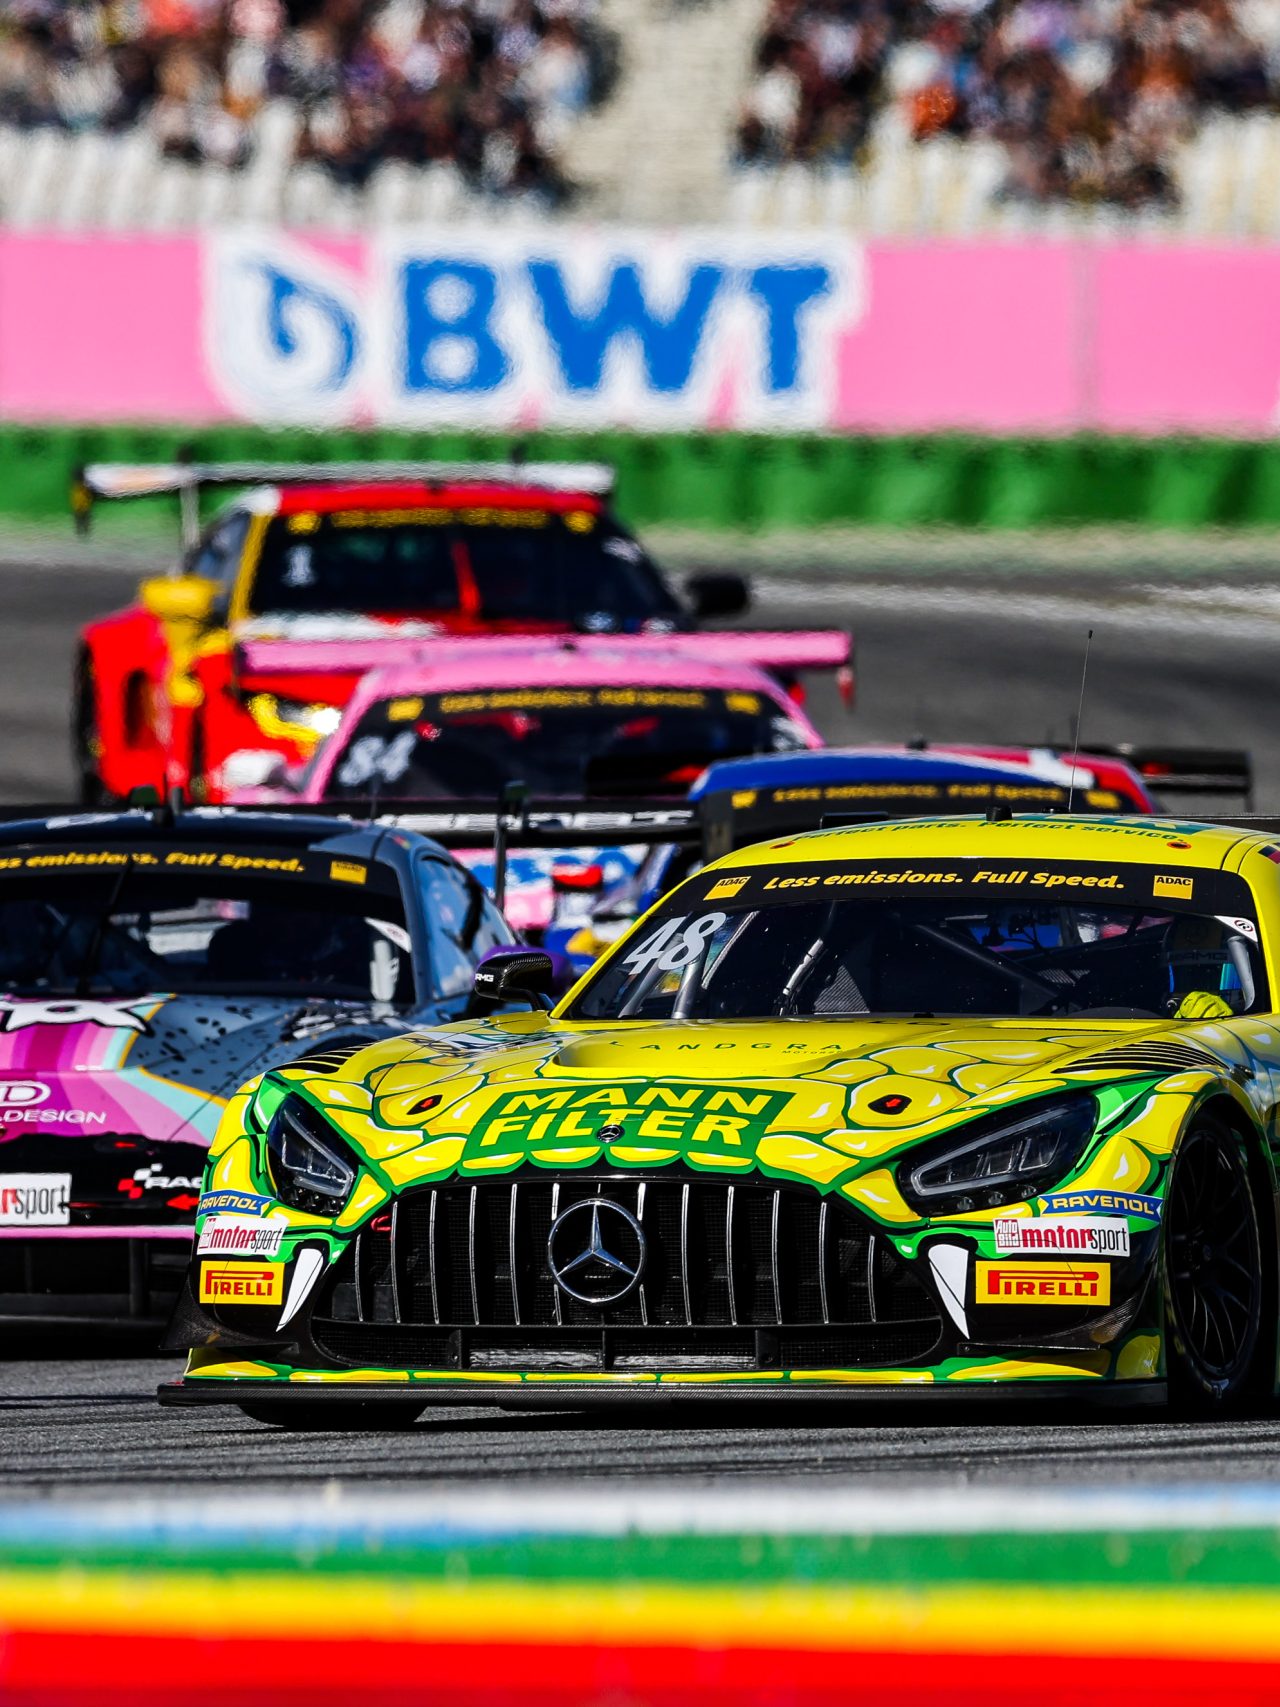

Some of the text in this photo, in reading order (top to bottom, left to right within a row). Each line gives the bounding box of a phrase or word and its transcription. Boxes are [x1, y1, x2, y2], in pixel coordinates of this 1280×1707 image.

[404, 260, 831, 393] BWT
[717, 877, 748, 887] ADAC
[763, 870, 1125, 890] Less emissions. Full Speed.
[1156, 876, 1192, 886] ADAC
[622, 912, 726, 975] 48
[498, 1087, 772, 1115] MANN
[479, 1108, 750, 1147] FILTER
[201, 1195, 259, 1211] RAVENOL
[1052, 1195, 1155, 1215] RAVENOL
[210, 1224, 282, 1253] motorsport
[1021, 1224, 1128, 1253] motorsport
[205, 1270, 274, 1296] PIRELLI
[987, 1270, 1100, 1297] PIRELLI
